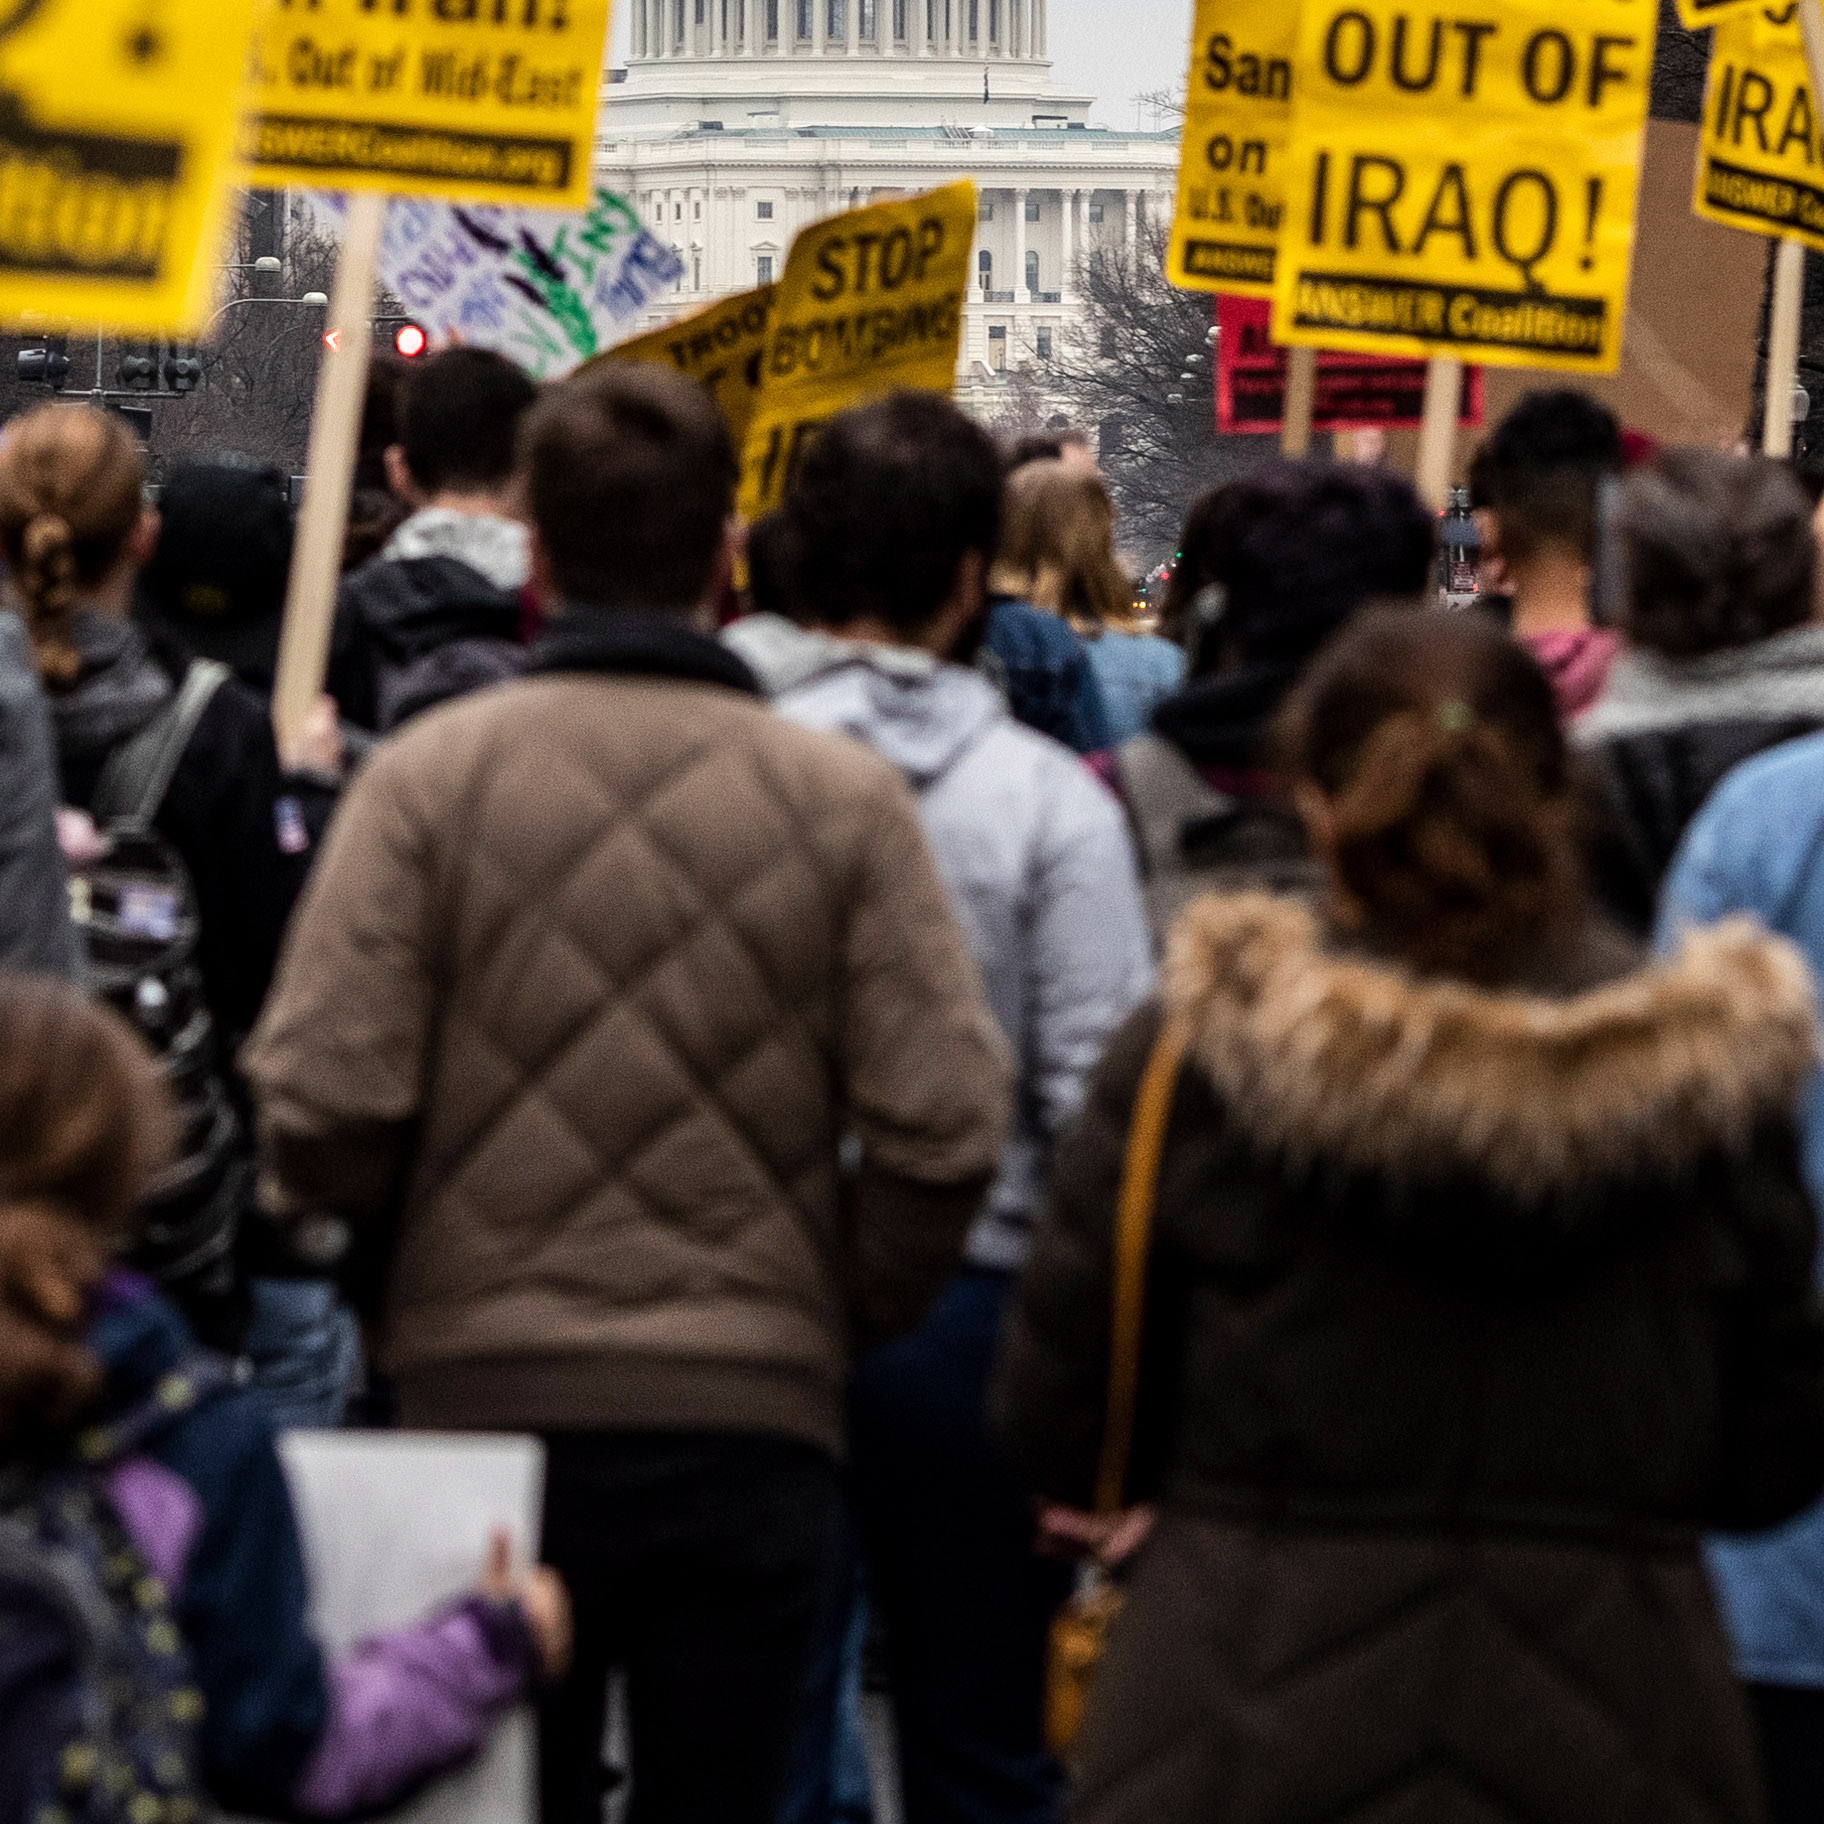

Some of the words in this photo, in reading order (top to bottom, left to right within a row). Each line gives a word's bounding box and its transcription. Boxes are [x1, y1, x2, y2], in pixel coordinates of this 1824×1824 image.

[1323, 8, 1498, 101] OUT
[1522, 27, 1636, 110] OF
[1206, 132, 1265, 174] on
[812, 215, 944, 301] STOP
[1307, 149, 1605, 294] IRAQ!
[1298, 280, 1446, 334] ANSWER
[1449, 296, 1603, 349] Coalition
